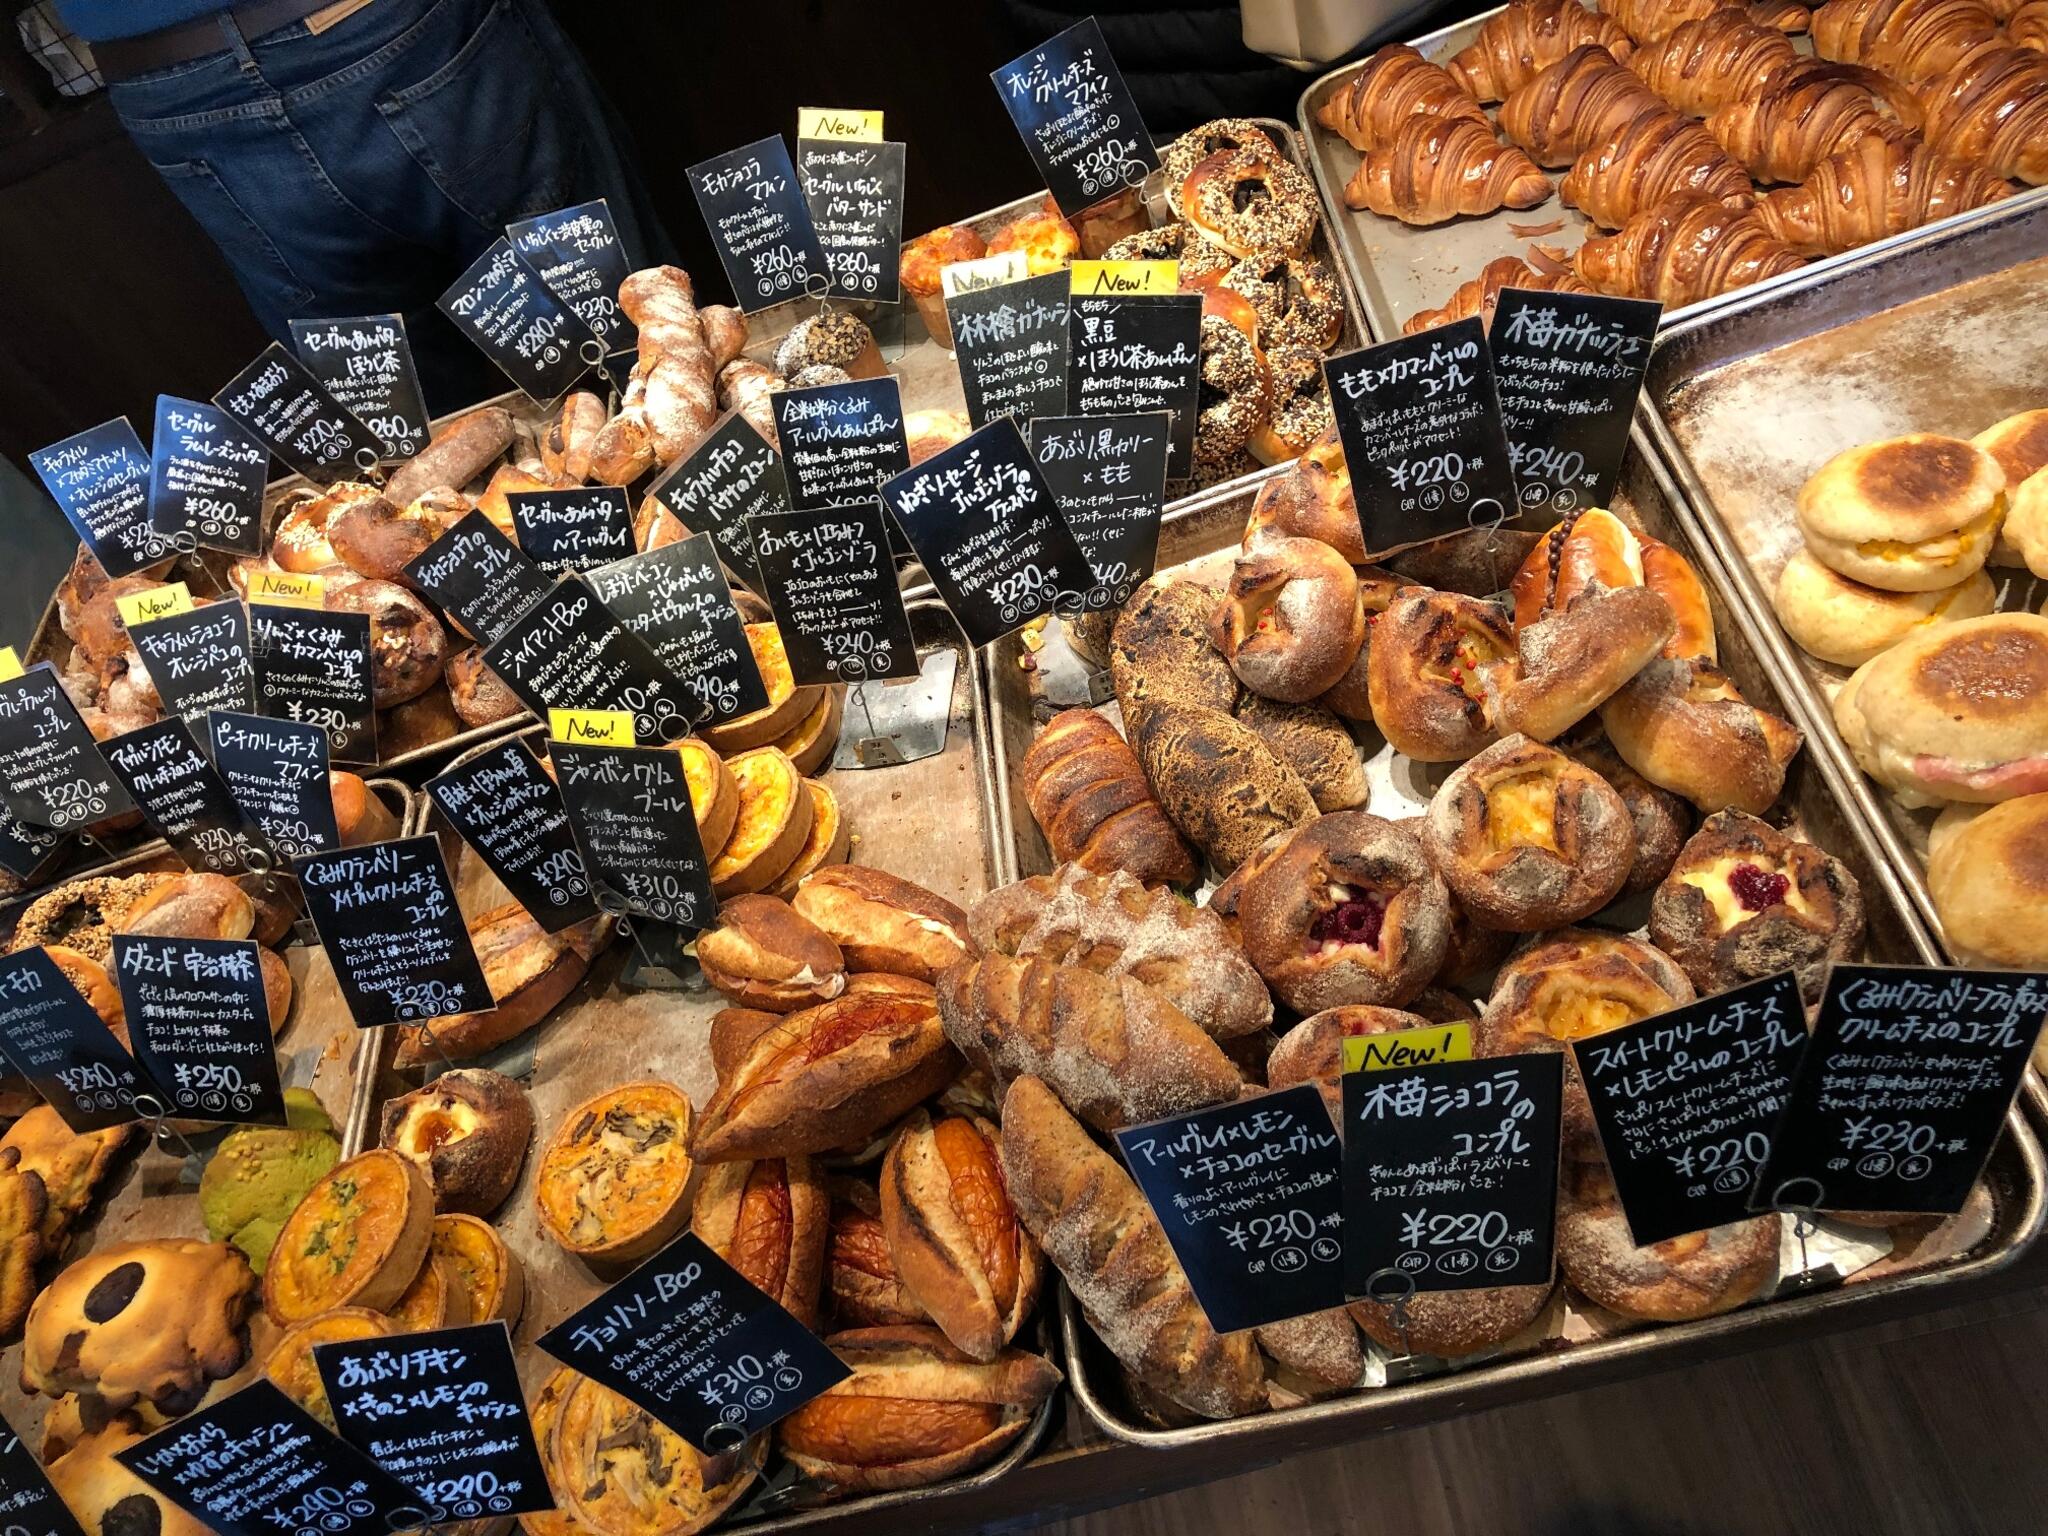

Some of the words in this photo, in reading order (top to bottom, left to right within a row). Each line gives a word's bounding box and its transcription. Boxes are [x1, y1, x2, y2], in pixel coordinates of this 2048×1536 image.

[1007, 52, 1048, 98] オレンジ
[1036, 49, 1096, 103] クリームチーズ
[1065, 75, 1109, 105] マフィン
[815, 117, 868, 137] New!
[1073, 139, 1123, 179] ¥260
[751, 244, 794, 276] ¥260
[1093, 269, 1150, 295] New!
[1081, 316, 1117, 347] 黒豆
[293, 419, 335, 456] ¥220
[1387, 452, 1463, 491] ¥220
[184, 496, 237, 524] ¥260
[261, 576, 311, 595] New!
[986, 563, 1043, 606] ¥230
[138, 592, 180, 623] New!
[821, 630, 874, 656] ¥240
[566, 718, 615, 741] New!
[38, 778, 93, 809] ¥220
[634, 787, 686, 813] ブール
[260, 817, 309, 843] ¥260
[532, 848, 585, 888] ¥290
[622, 873, 679, 898] ¥310
[183, 947, 255, 982] 宇治抹茶
[1360, 1032, 1453, 1071] New!
[56, 1061, 118, 1093] ¥250
[174, 1062, 242, 1093] ¥250
[1453, 1119, 1531, 1156] コンプレ
[1840, 1116, 1936, 1154] ¥230
[1667, 1131, 1771, 1177] ¥220
[1219, 1209, 1316, 1252] ¥230
[1399, 1208, 1509, 1248] ¥220
[698, 1354, 765, 1406] ¥310
[417, 1469, 500, 1505] ¥290
[262, 1485, 345, 1529] ¥290
